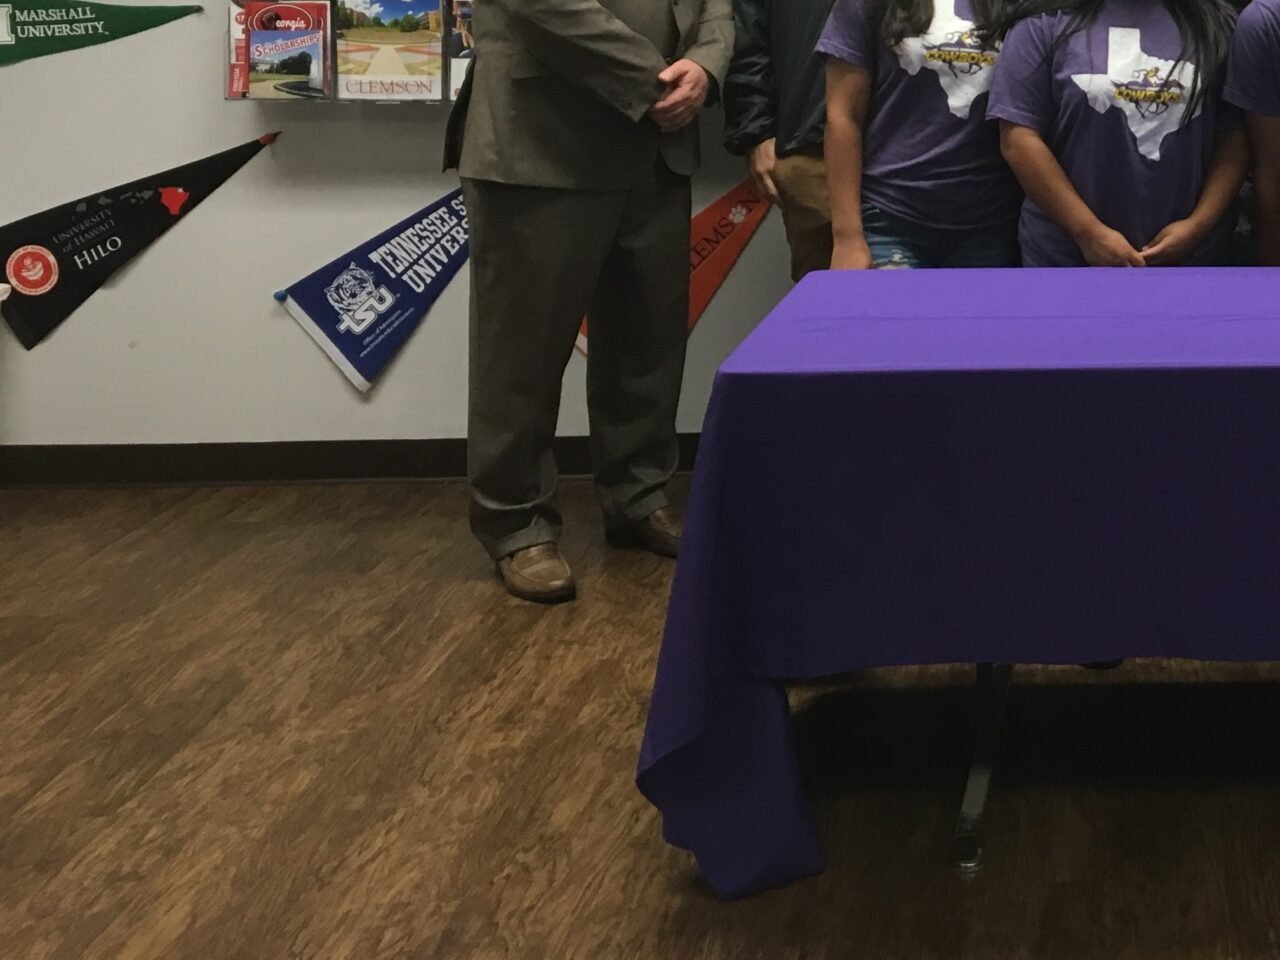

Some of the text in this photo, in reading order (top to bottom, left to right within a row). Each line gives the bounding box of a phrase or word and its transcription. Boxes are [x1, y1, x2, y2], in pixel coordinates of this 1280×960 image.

[15, 6, 95, 22] MARSHALL
[16, 21, 105, 38] UNIVERSITY
[254, 34, 321, 58] SCHOLARSHIPS
[925, 49, 995, 66] COWBOYS
[344, 79, 433, 95] CLEMSON
[1113, 86, 1181, 102] COWBOYS
[368, 206, 460, 279] TENNESSEE
[73, 235, 123, 271] HILO
